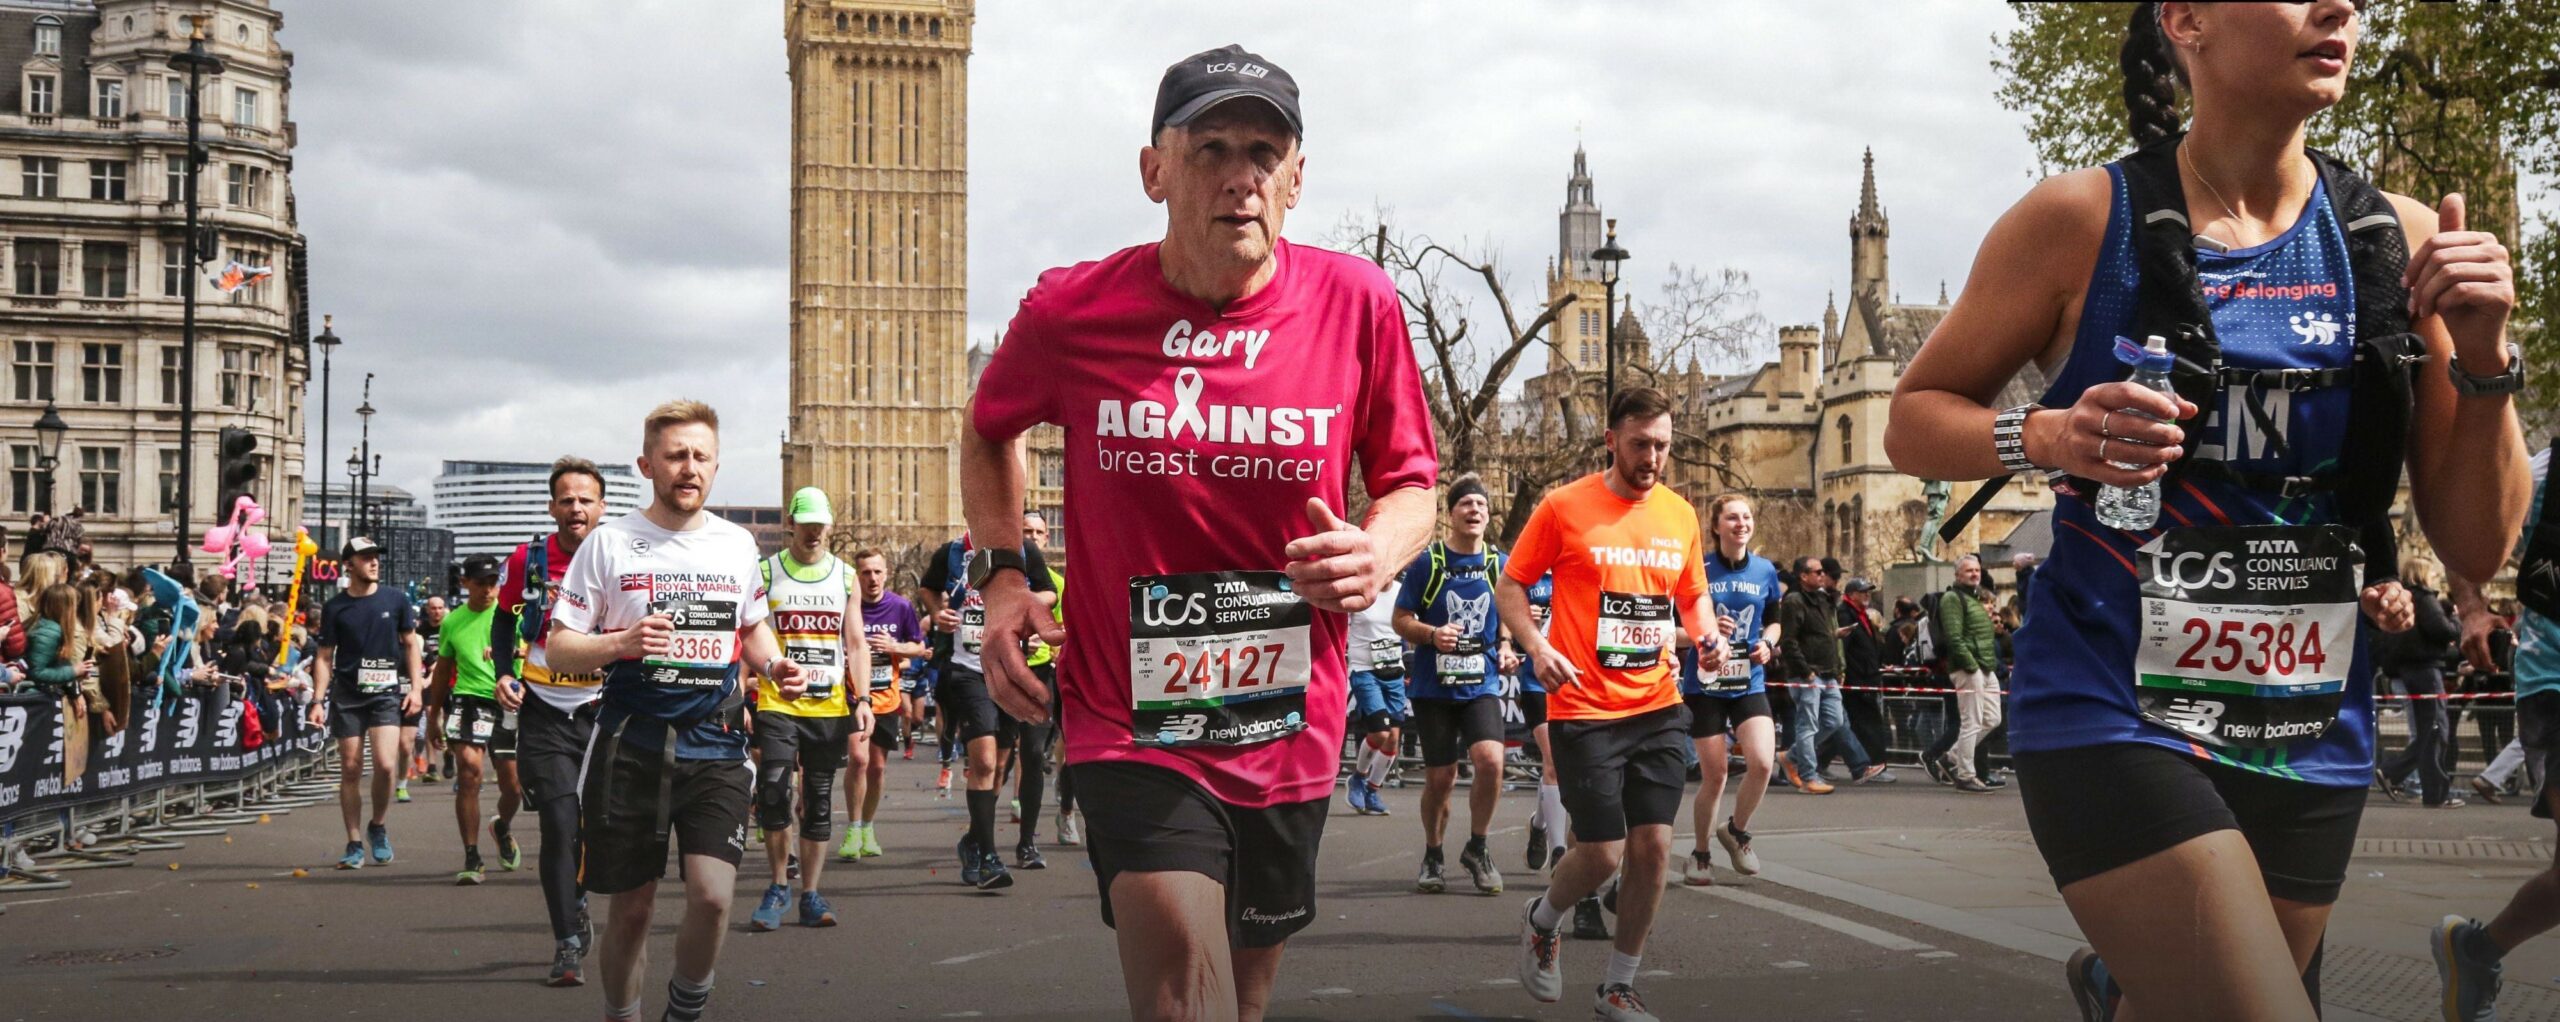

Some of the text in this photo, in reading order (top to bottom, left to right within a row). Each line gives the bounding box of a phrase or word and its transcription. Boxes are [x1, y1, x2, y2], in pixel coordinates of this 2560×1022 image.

[1206, 62, 1237, 74] tcs
[2234, 281, 2337, 300] Belonging
[1162, 319, 1270, 369] Gary
[1098, 440, 1325, 482] breast cancer
[2245, 540, 2300, 554] TATA
[1589, 546, 1683, 571] THOMAS
[2246, 557, 2339, 573] CONSULTANCY
[312, 554, 338, 580] tcs
[2152, 550, 2237, 590] tcs
[655, 573, 736, 584] ROYAL NAVY &
[2247, 576, 2309, 591] SERVICES
[655, 583, 742, 594] ROYAL MARINES
[1214, 581, 1250, 594] TATA
[1710, 580, 1761, 596] FOX FAMILY
[656, 592, 705, 601] CHARITY
[785, 594, 836, 606] JUSTIN
[1215, 591, 1296, 609] CONSULTANCY
[689, 604, 709, 612] TATA
[1143, 585, 1208, 627] tcs
[1604, 595, 1632, 615] tcs
[689, 612, 732, 620] CONSULTANCY
[689, 619, 718, 627] SERVICES
[777, 614, 841, 631] LOROS
[965, 613, 982, 624] tcs
[1215, 607, 1271, 624] SERVICES
[1611, 626, 1661, 645] 12665
[665, 638, 722, 661] 3366
[2175, 617, 2326, 676] 25384
[361, 658, 377, 668] tcs
[787, 649, 807, 662] tcs
[1163, 643, 1285, 694] 24127
[364, 672, 391, 683] 24224
[678, 677, 694, 685] new
[2181, 678, 2207, 687] MEDAL
[1210, 718, 1291, 740] new balanc
[2224, 720, 2323, 739] new balance
